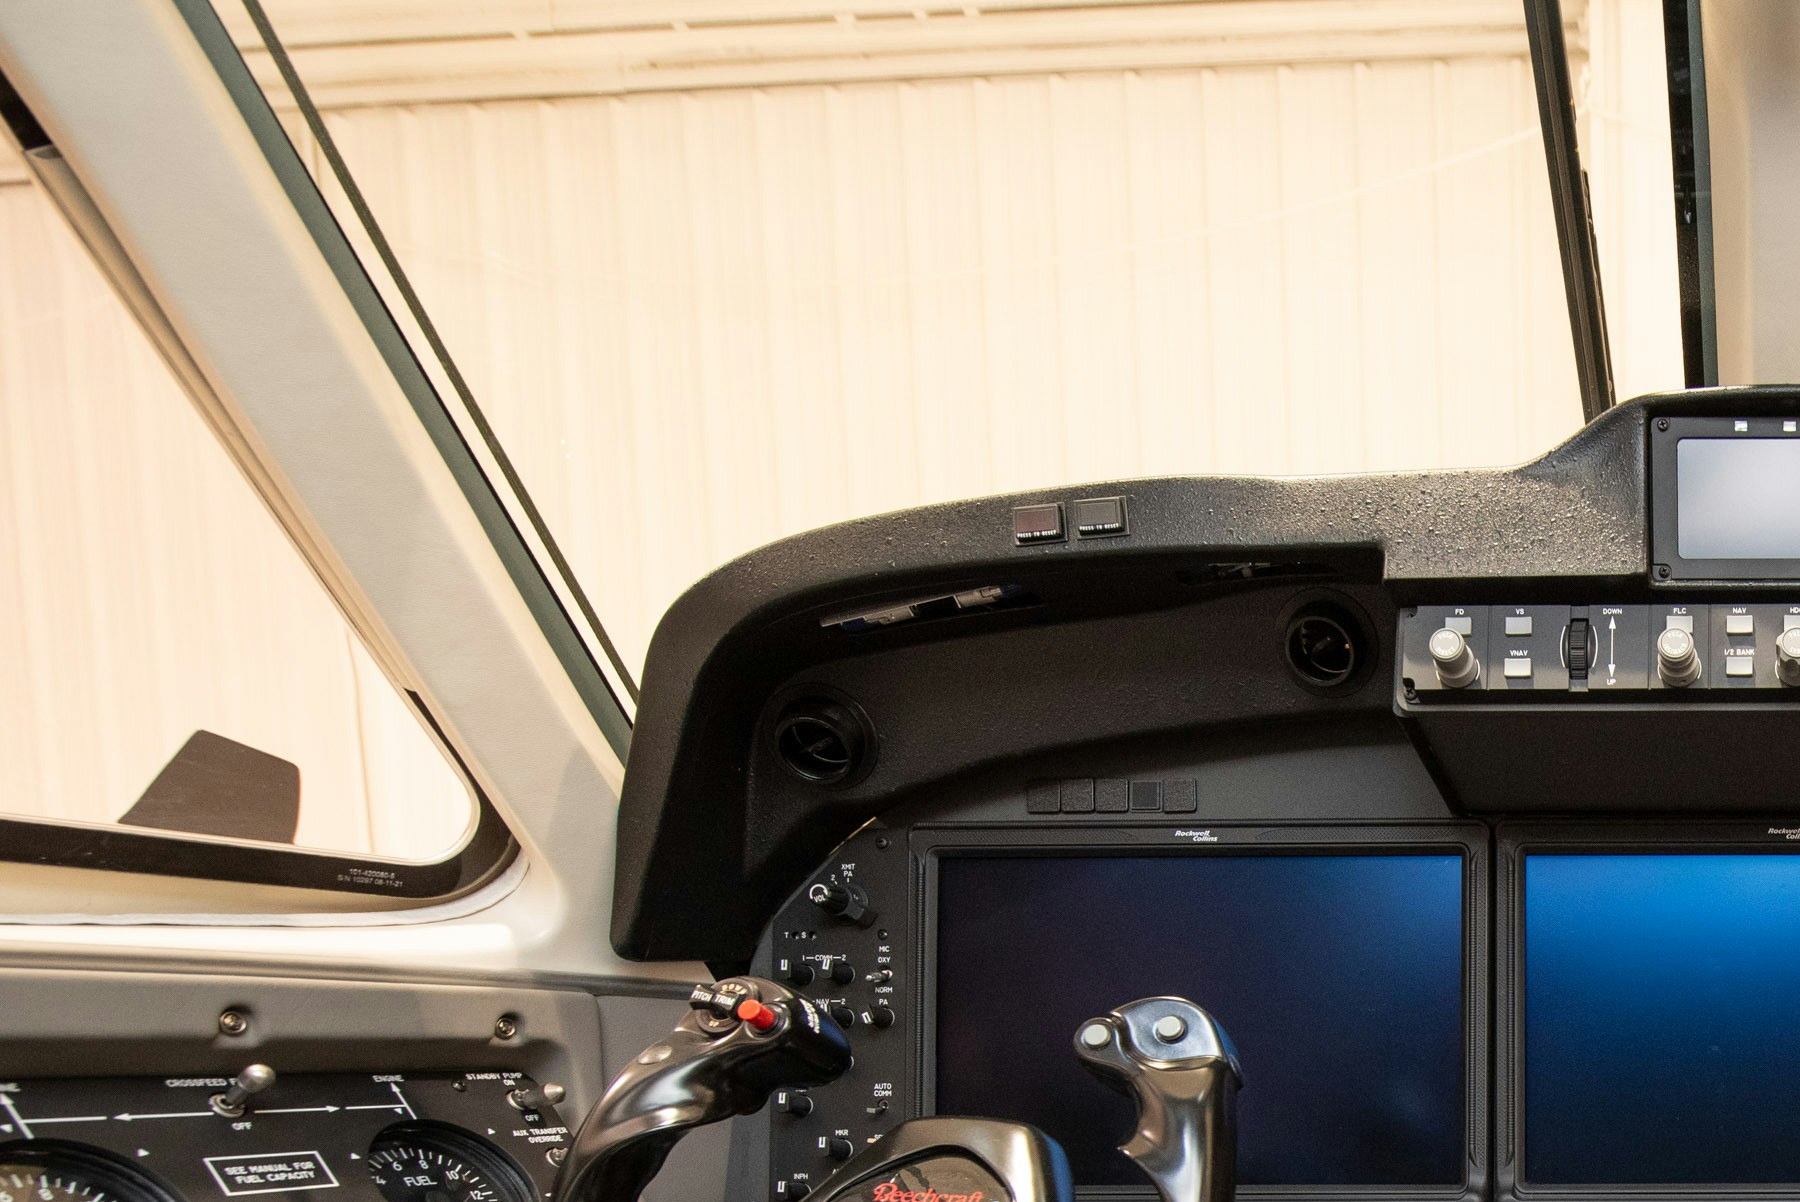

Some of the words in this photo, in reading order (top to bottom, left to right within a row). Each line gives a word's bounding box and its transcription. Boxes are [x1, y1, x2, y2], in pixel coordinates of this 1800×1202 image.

[530, 1127, 568, 1135] TRANSFER
[529, 1135, 563, 1143] OVERRIDE
[225, 1167, 247, 1176] SEE
[250, 1164, 291, 1173] MANUAL
[293, 1162, 315, 1170] FOR
[235, 1174, 264, 1184] FUEL
[267, 1171, 315, 1181] CAPACITY
[404, 1176, 437, 1186] FUEL
